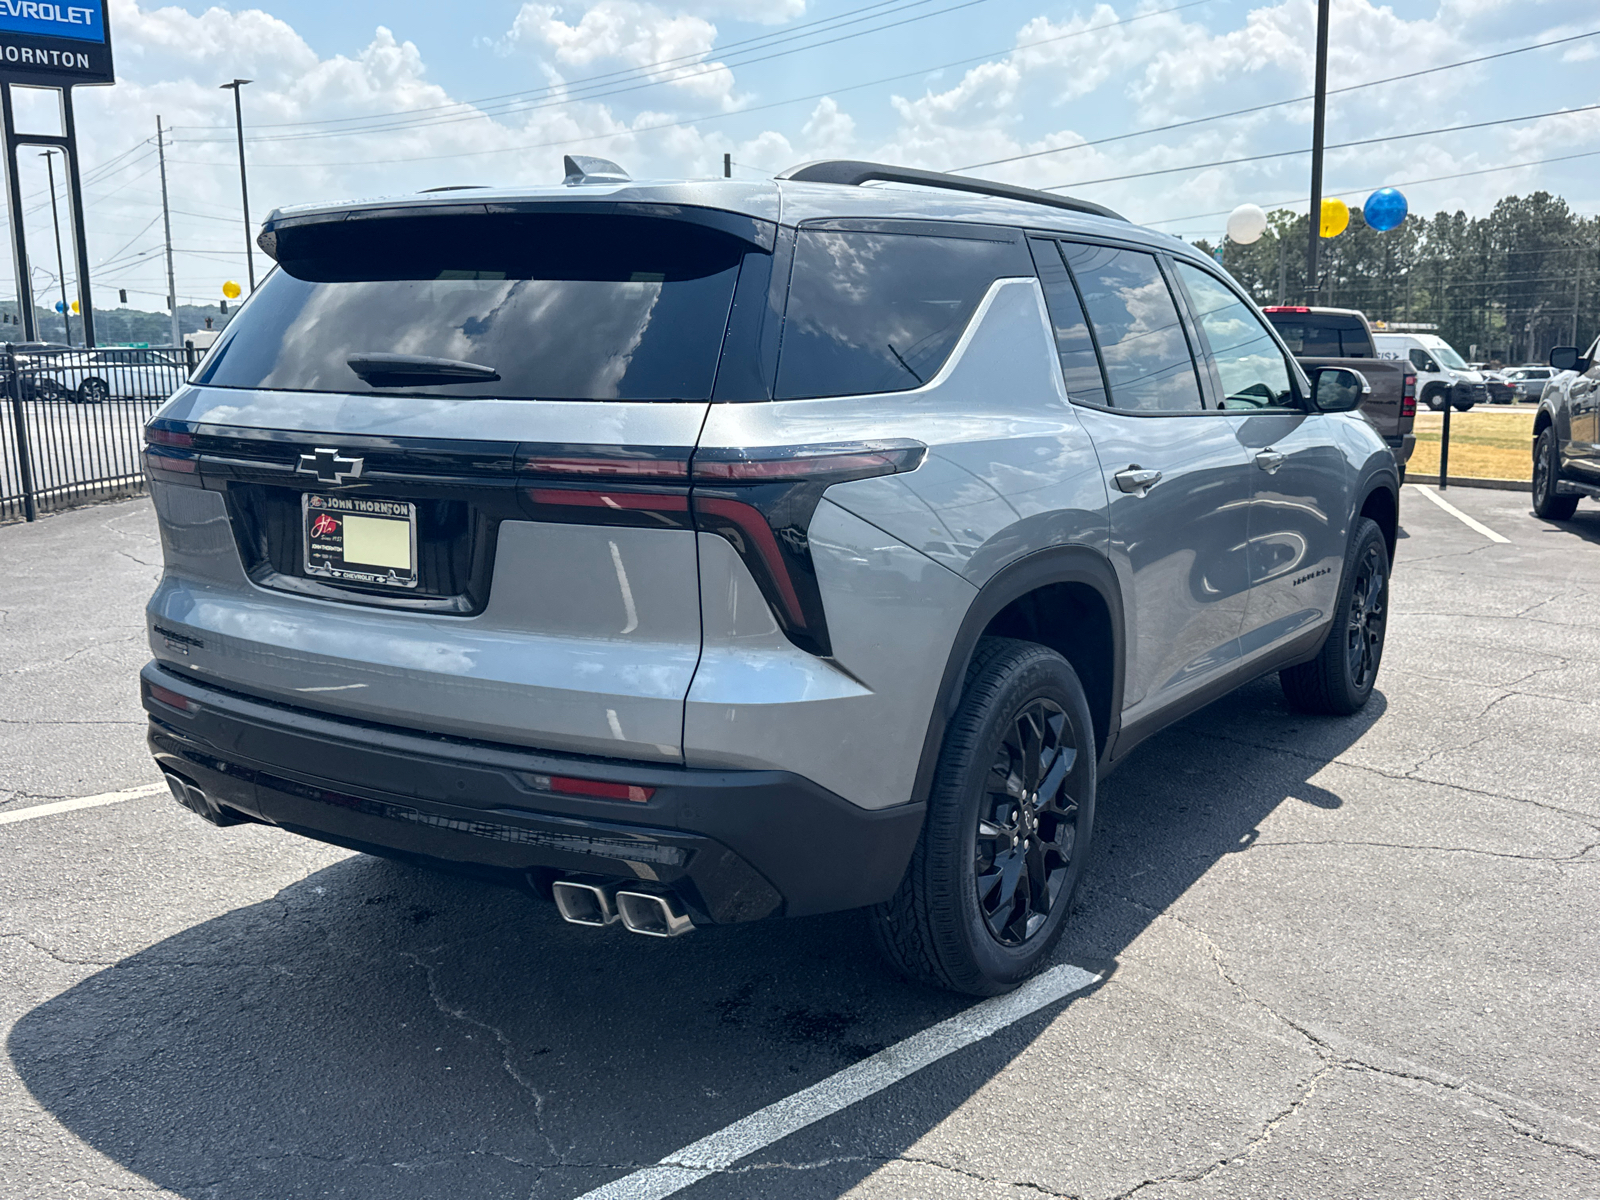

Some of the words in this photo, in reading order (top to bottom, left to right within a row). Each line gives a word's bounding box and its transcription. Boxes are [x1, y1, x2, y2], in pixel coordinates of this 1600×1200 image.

[0, 45, 90, 69] ORNTON
[328, 497, 353, 510] JOHN
[354, 500, 408, 515] THORNTON
[342, 572, 375, 582] CHEVROLET
